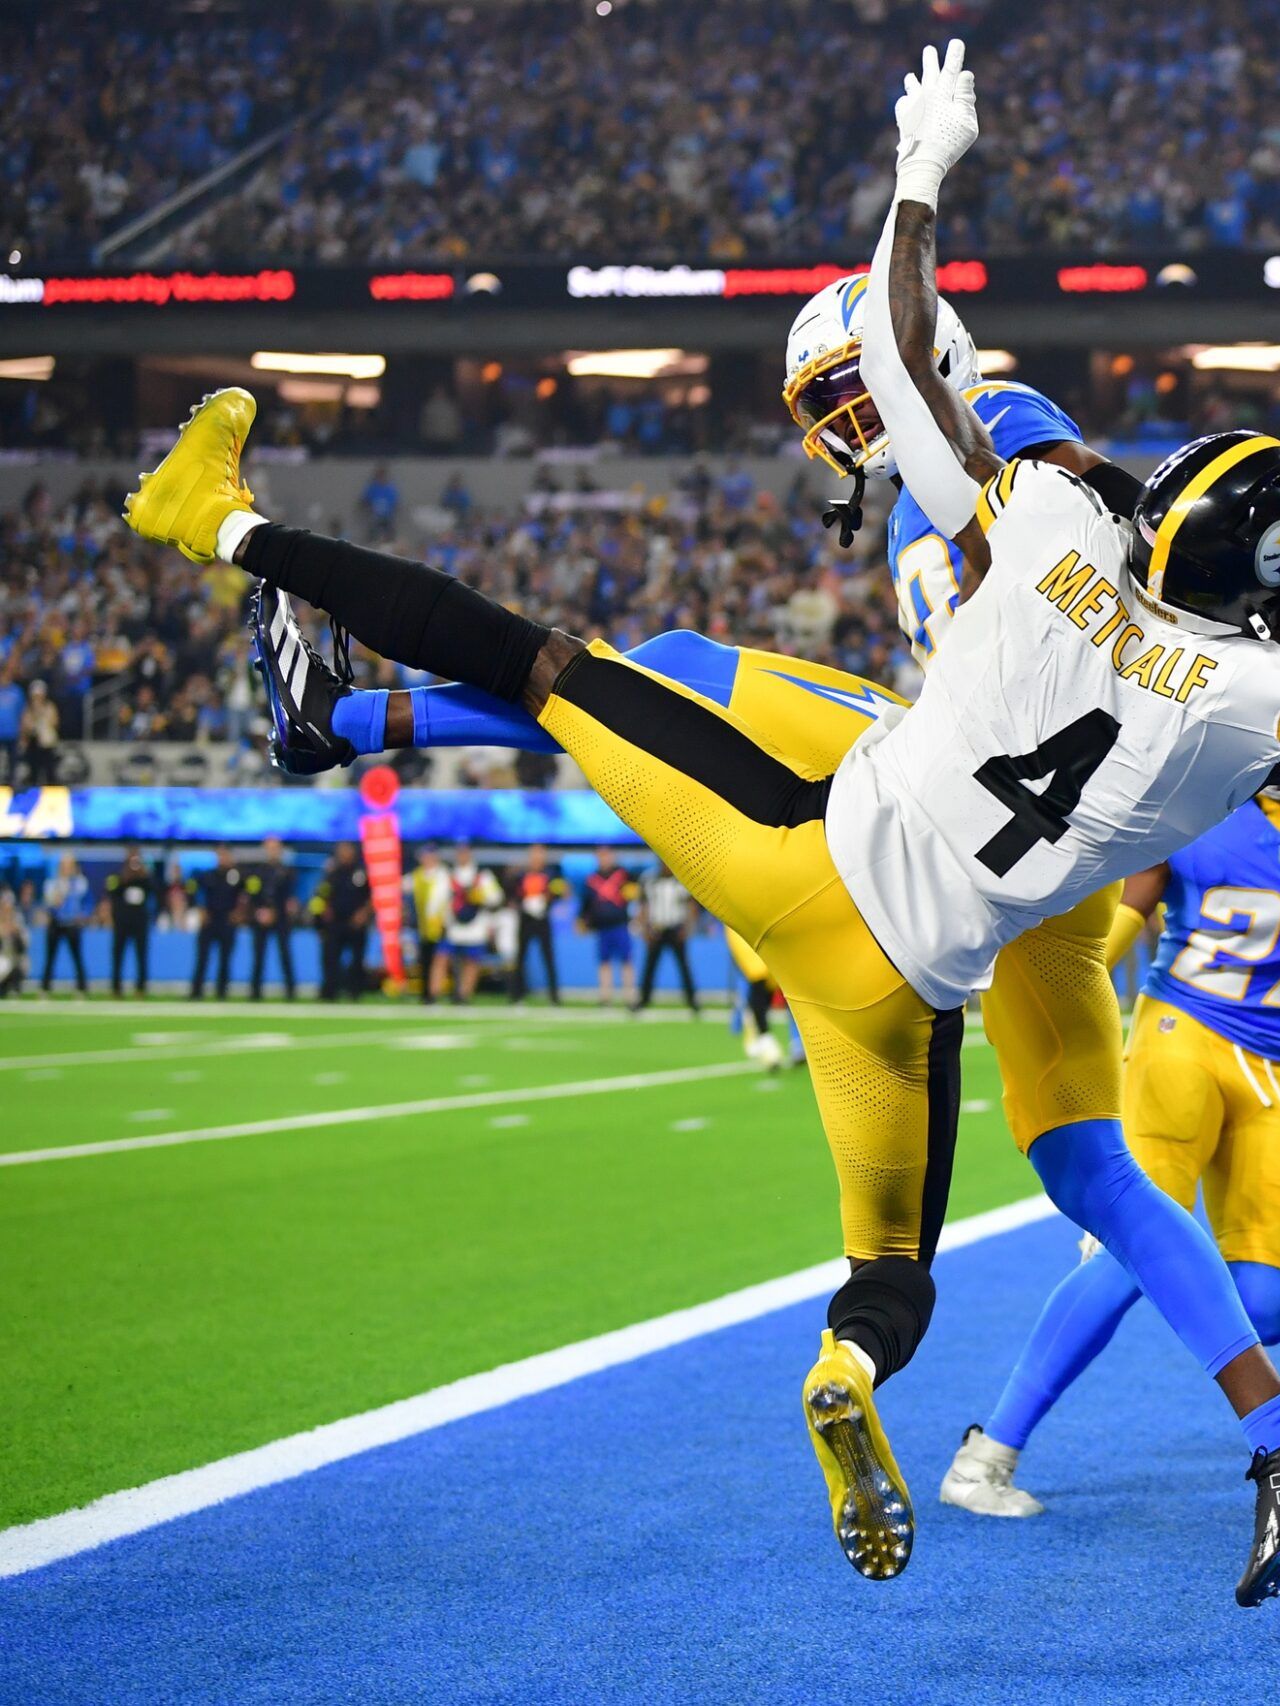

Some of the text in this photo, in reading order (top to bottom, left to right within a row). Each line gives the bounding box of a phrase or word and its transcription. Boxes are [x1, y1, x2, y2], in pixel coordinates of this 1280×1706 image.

[1035, 549, 1218, 704] METCALF
[1135, 586, 1178, 625] Steelers
[972, 707, 1123, 879] 4
